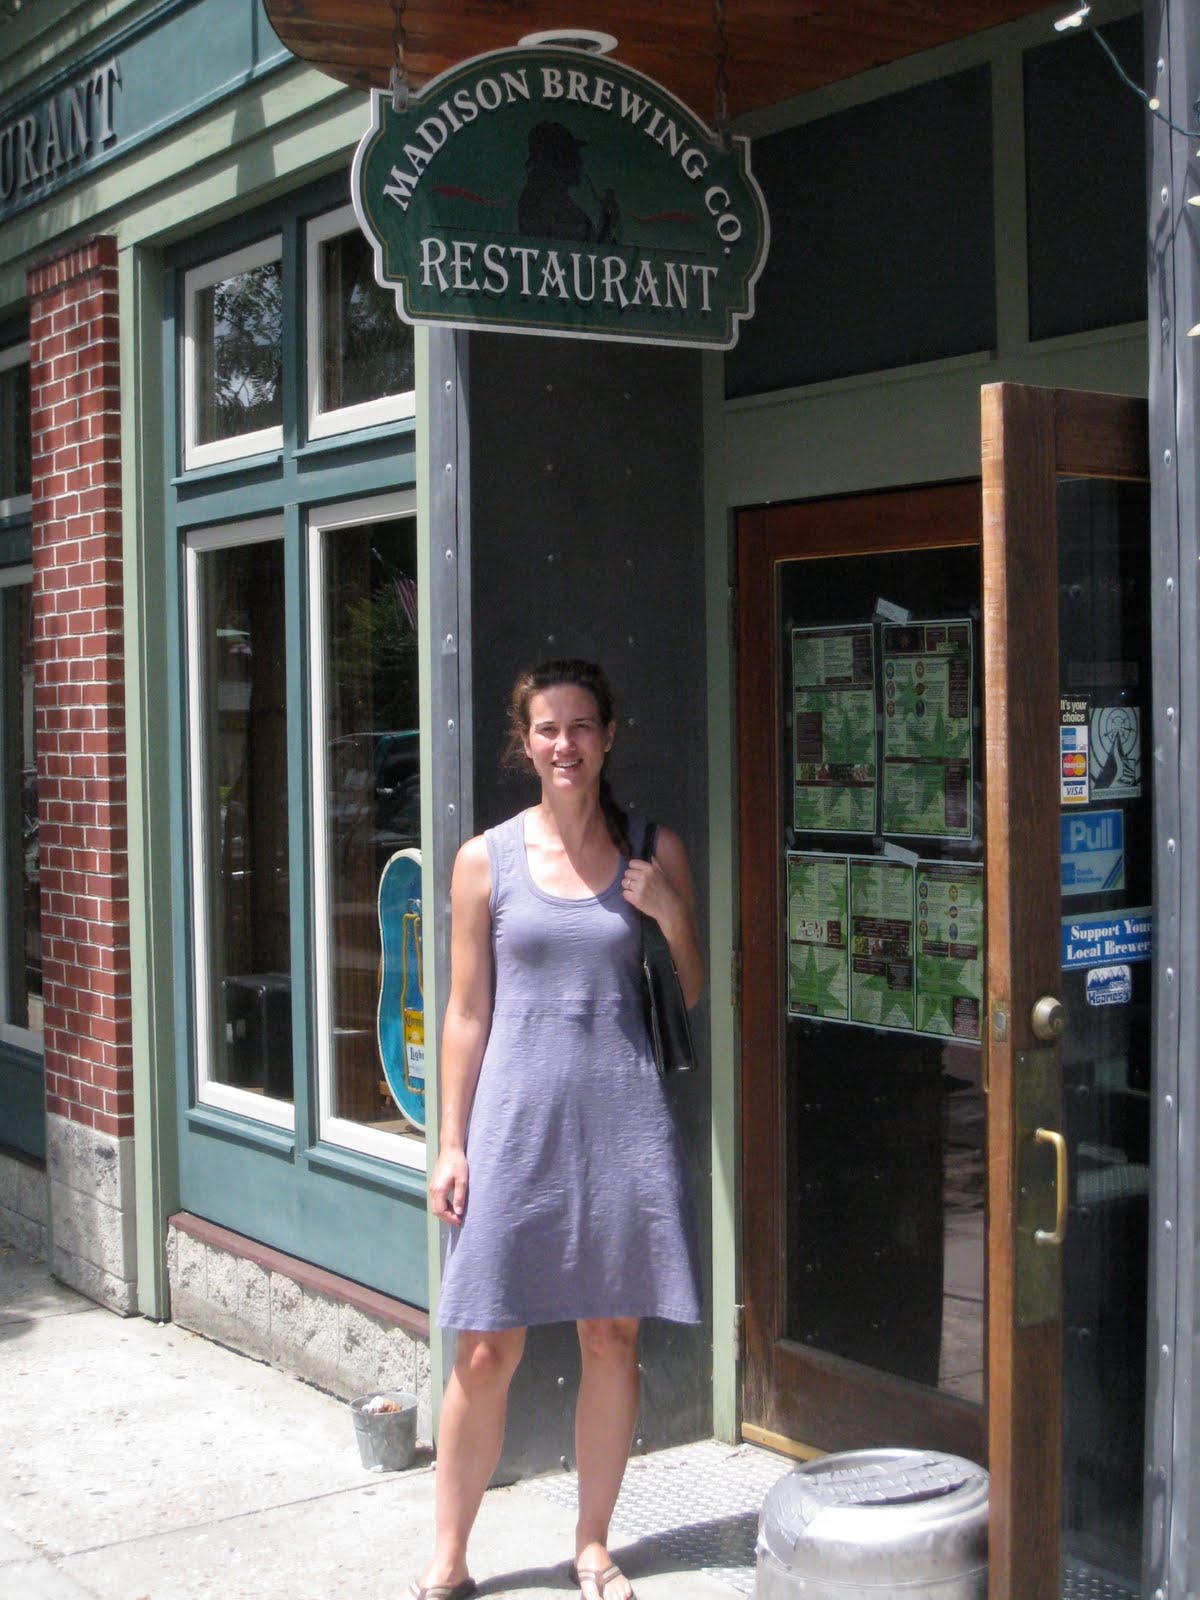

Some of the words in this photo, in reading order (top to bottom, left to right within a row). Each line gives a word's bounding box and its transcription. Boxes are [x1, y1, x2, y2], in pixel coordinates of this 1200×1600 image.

[383, 68, 531, 212] MADISON
[540, 67, 711, 183] BREWING
[704, 185, 743, 255] CO.
[419, 237, 719, 312] RESTAURANT
[1060, 699, 1071, 711] It's
[1071, 701, 1087, 713] your
[1062, 711, 1086, 723] choice
[1066, 786, 1084, 796] VISA
[1070, 817, 1113, 851] Pull
[1071, 924, 1120, 942] Support
[1066, 943, 1101, 960] Local
[1104, 940, 1152, 956] Brewer
[410, 1046, 424, 1062] Ligh
